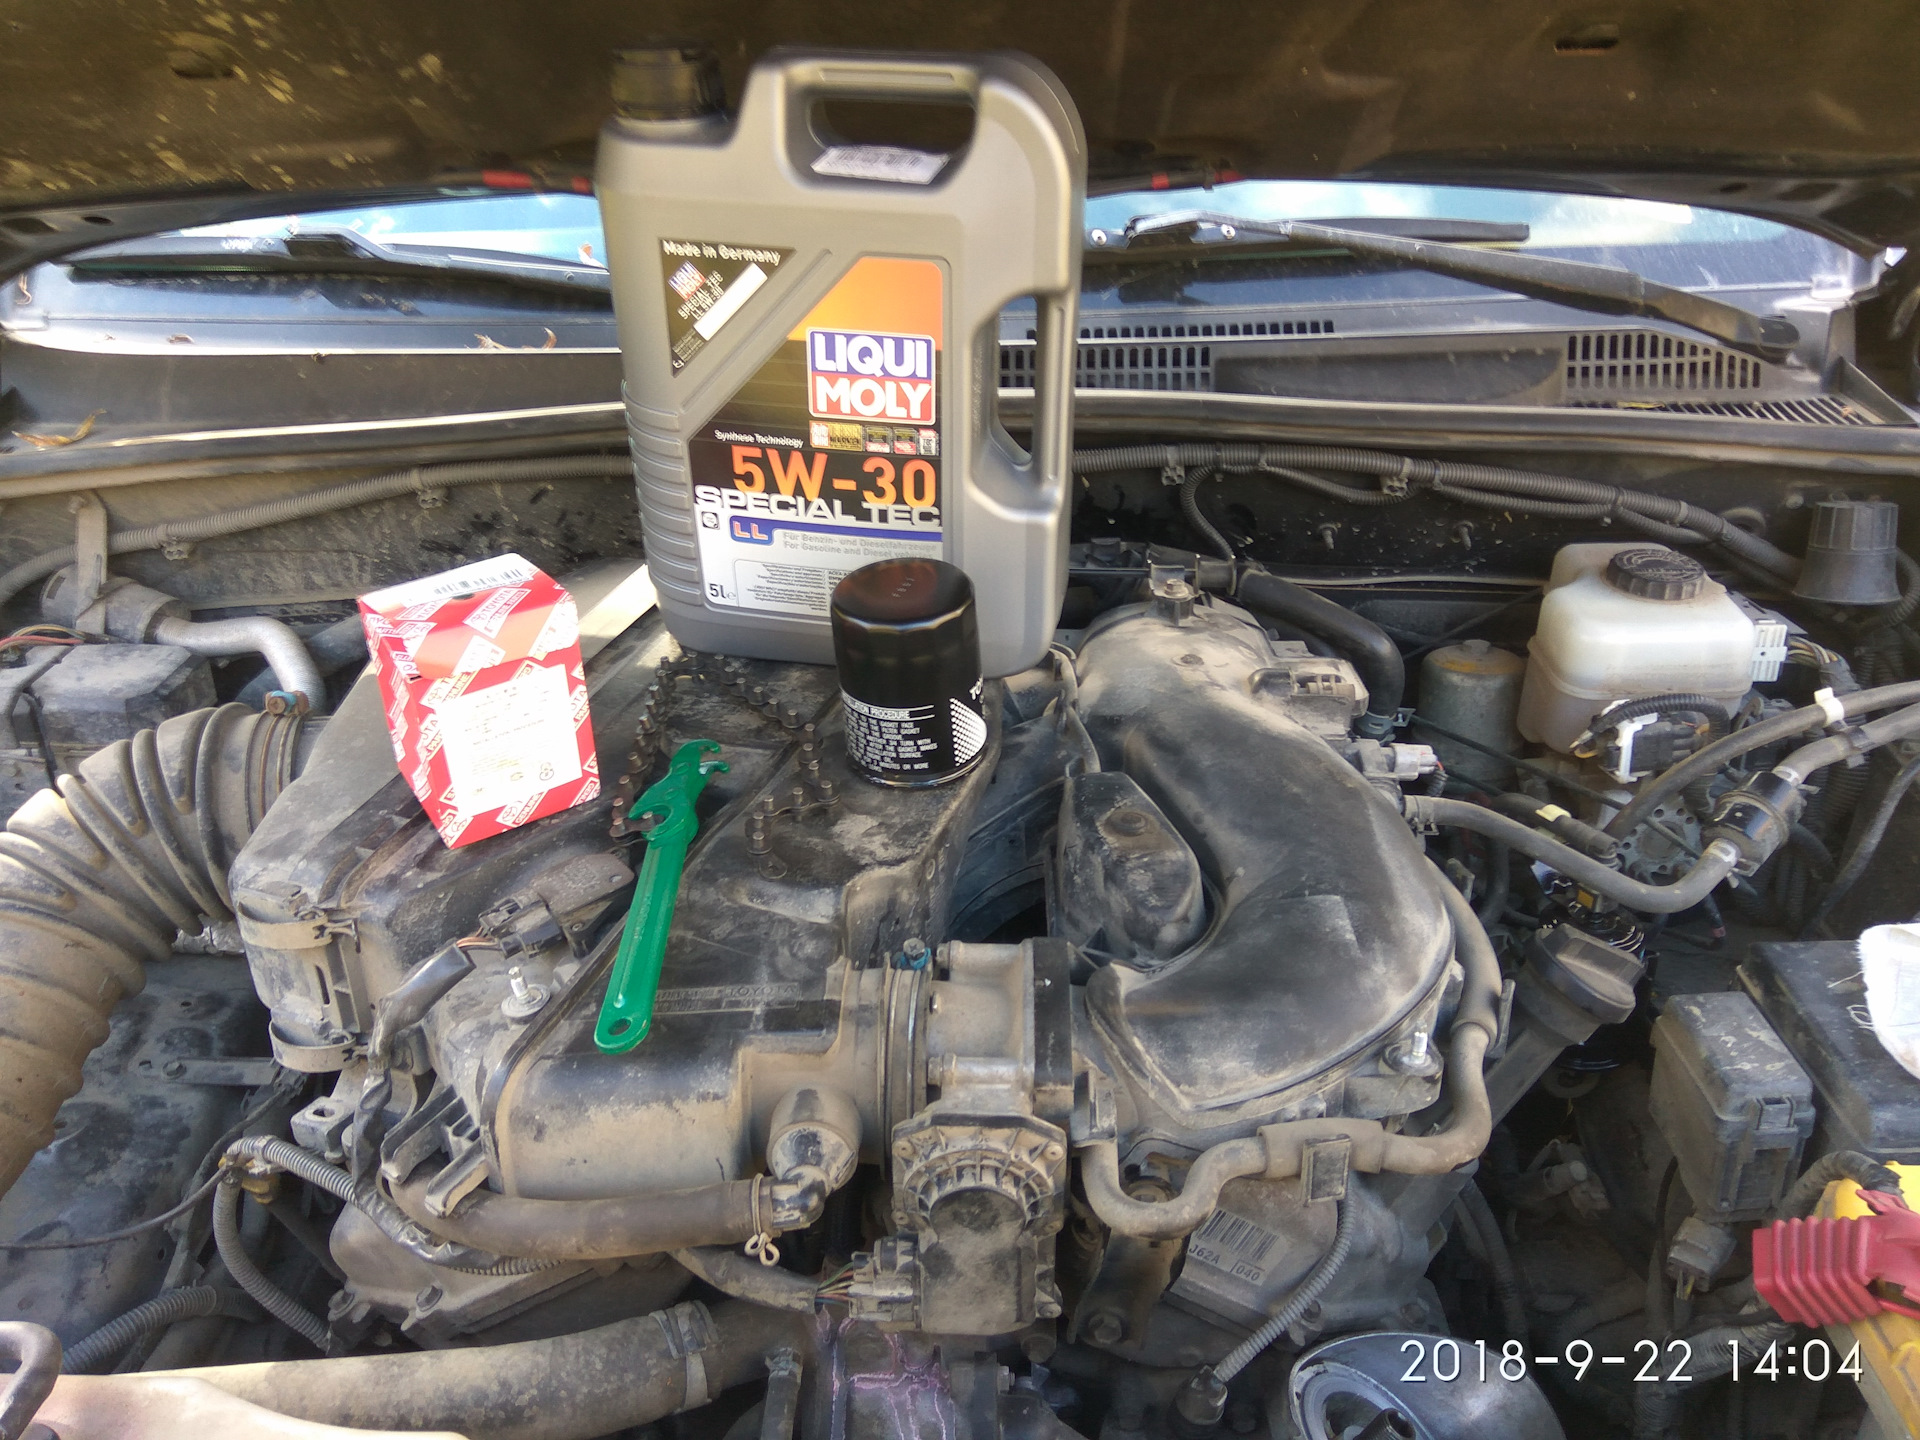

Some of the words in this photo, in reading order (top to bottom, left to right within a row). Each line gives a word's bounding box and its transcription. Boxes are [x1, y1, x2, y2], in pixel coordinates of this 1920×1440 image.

[662, 240, 701, 257] Made
[702, 243, 717, 258] in
[718, 244, 780, 266] Germany
[677, 288, 710, 320] SPECIAL
[706, 270, 724, 288] TEC
[812, 333, 928, 377] LIQUI
[815, 375, 931, 419] MOLY
[714, 429, 755, 443] Synthese
[754, 433, 804, 448] Technology
[731, 445, 936, 508] 5W-30
[695, 484, 857, 522] SPECIAL
[861, 501, 941, 526] TEC
[733, 520, 768, 540] LL
[840, 537, 857, 546] und
[784, 541, 799, 549] For
[802, 543, 841, 553] Gasoline
[844, 547, 861, 555] and
[864, 548, 892, 557] Diesel
[1189, 1244, 1221, 1264] J62A
[1236, 1265, 1261, 1281] 040
